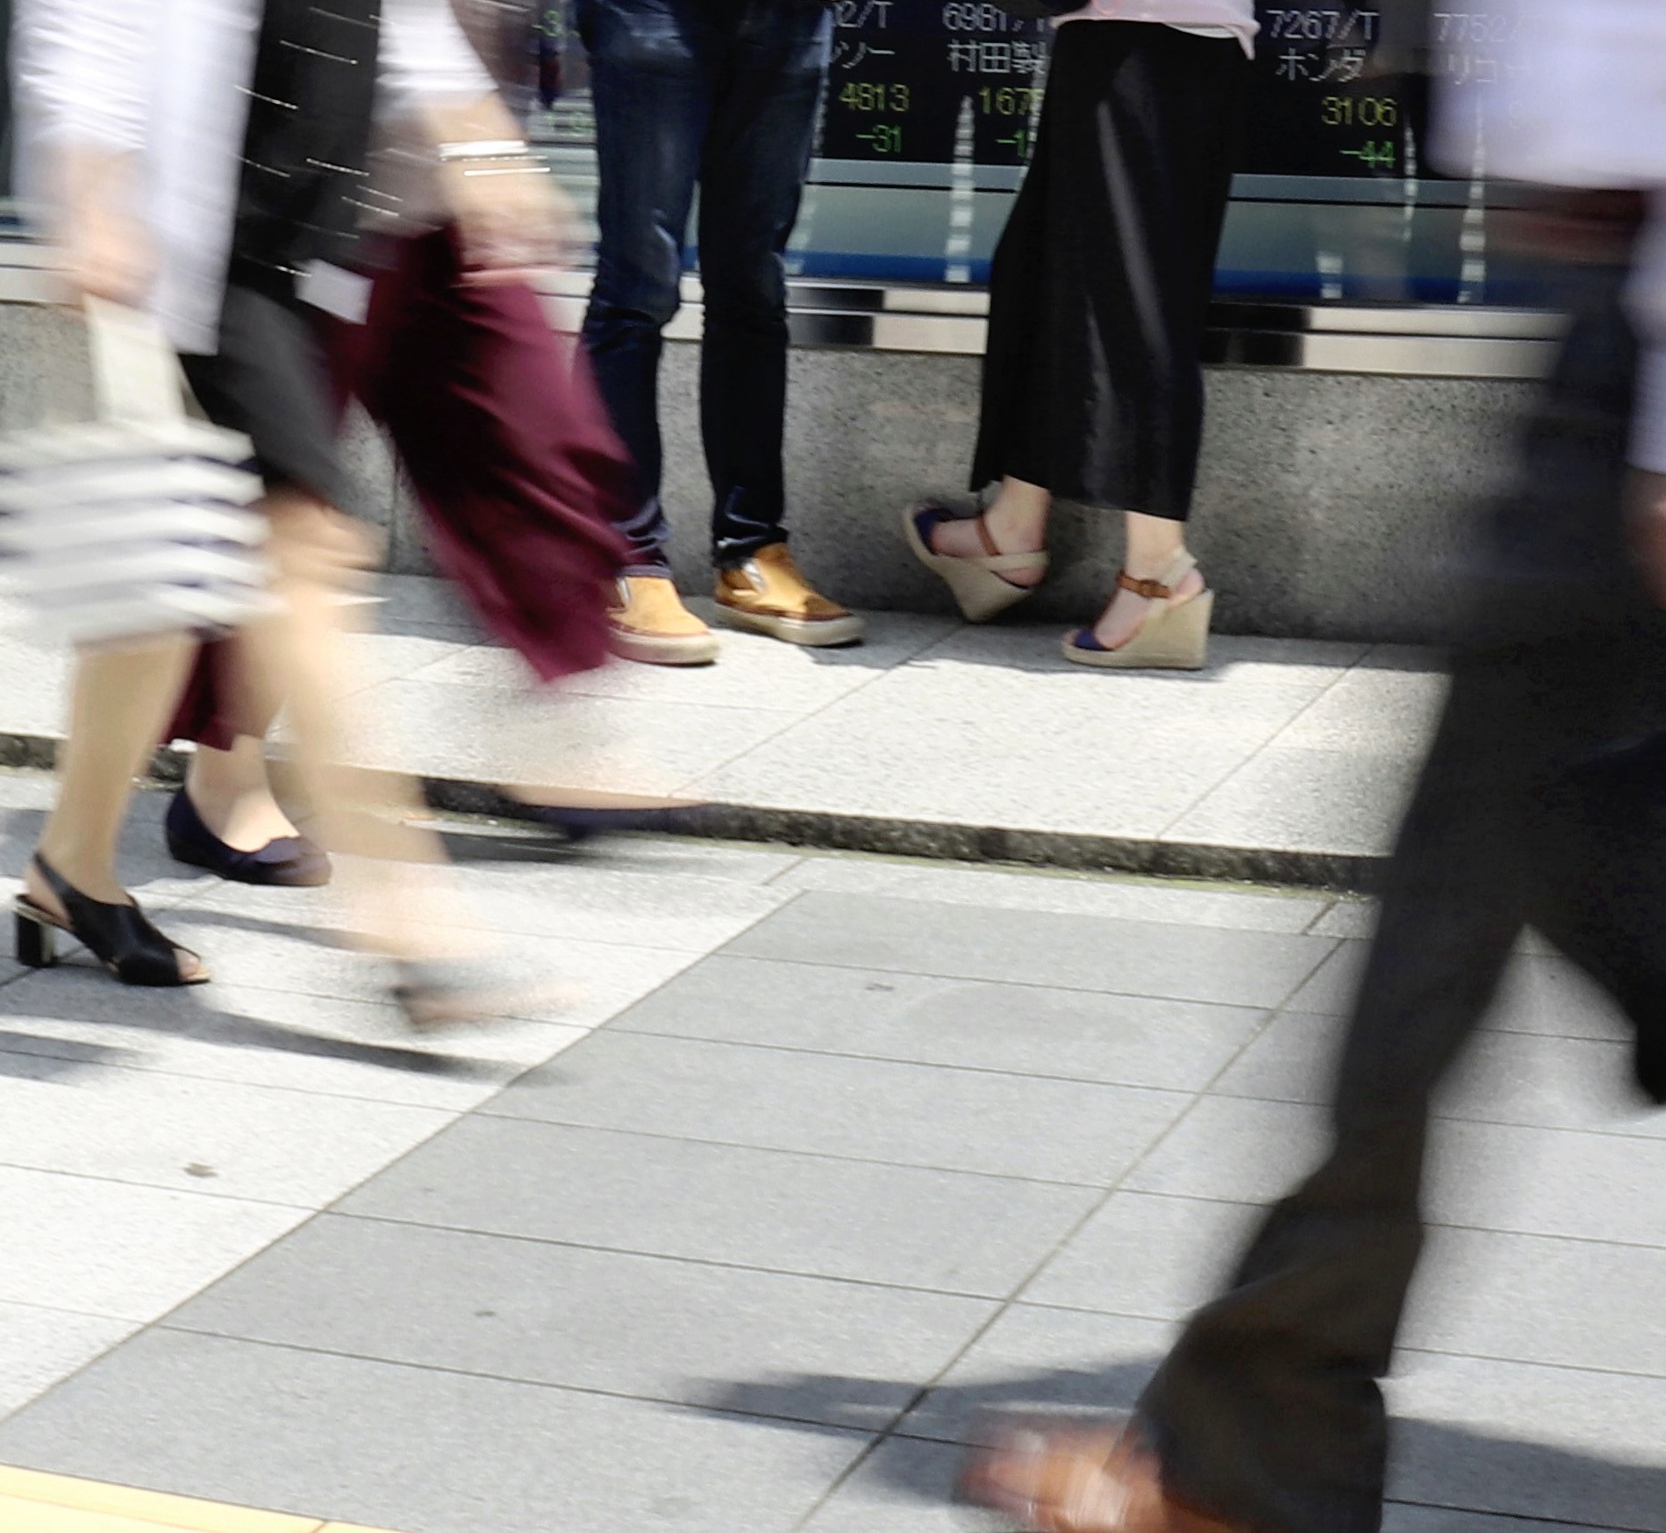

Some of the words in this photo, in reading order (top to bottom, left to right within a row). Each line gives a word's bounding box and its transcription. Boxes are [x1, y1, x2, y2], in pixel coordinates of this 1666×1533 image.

[1267, 9, 1380, 42] 7267/T
[1275, 45, 1367, 83] ホンダ
[1321, 97, 1397, 126] 3106
[856, 126, 902, 153] -31
[1339, 140, 1394, 168] -44
